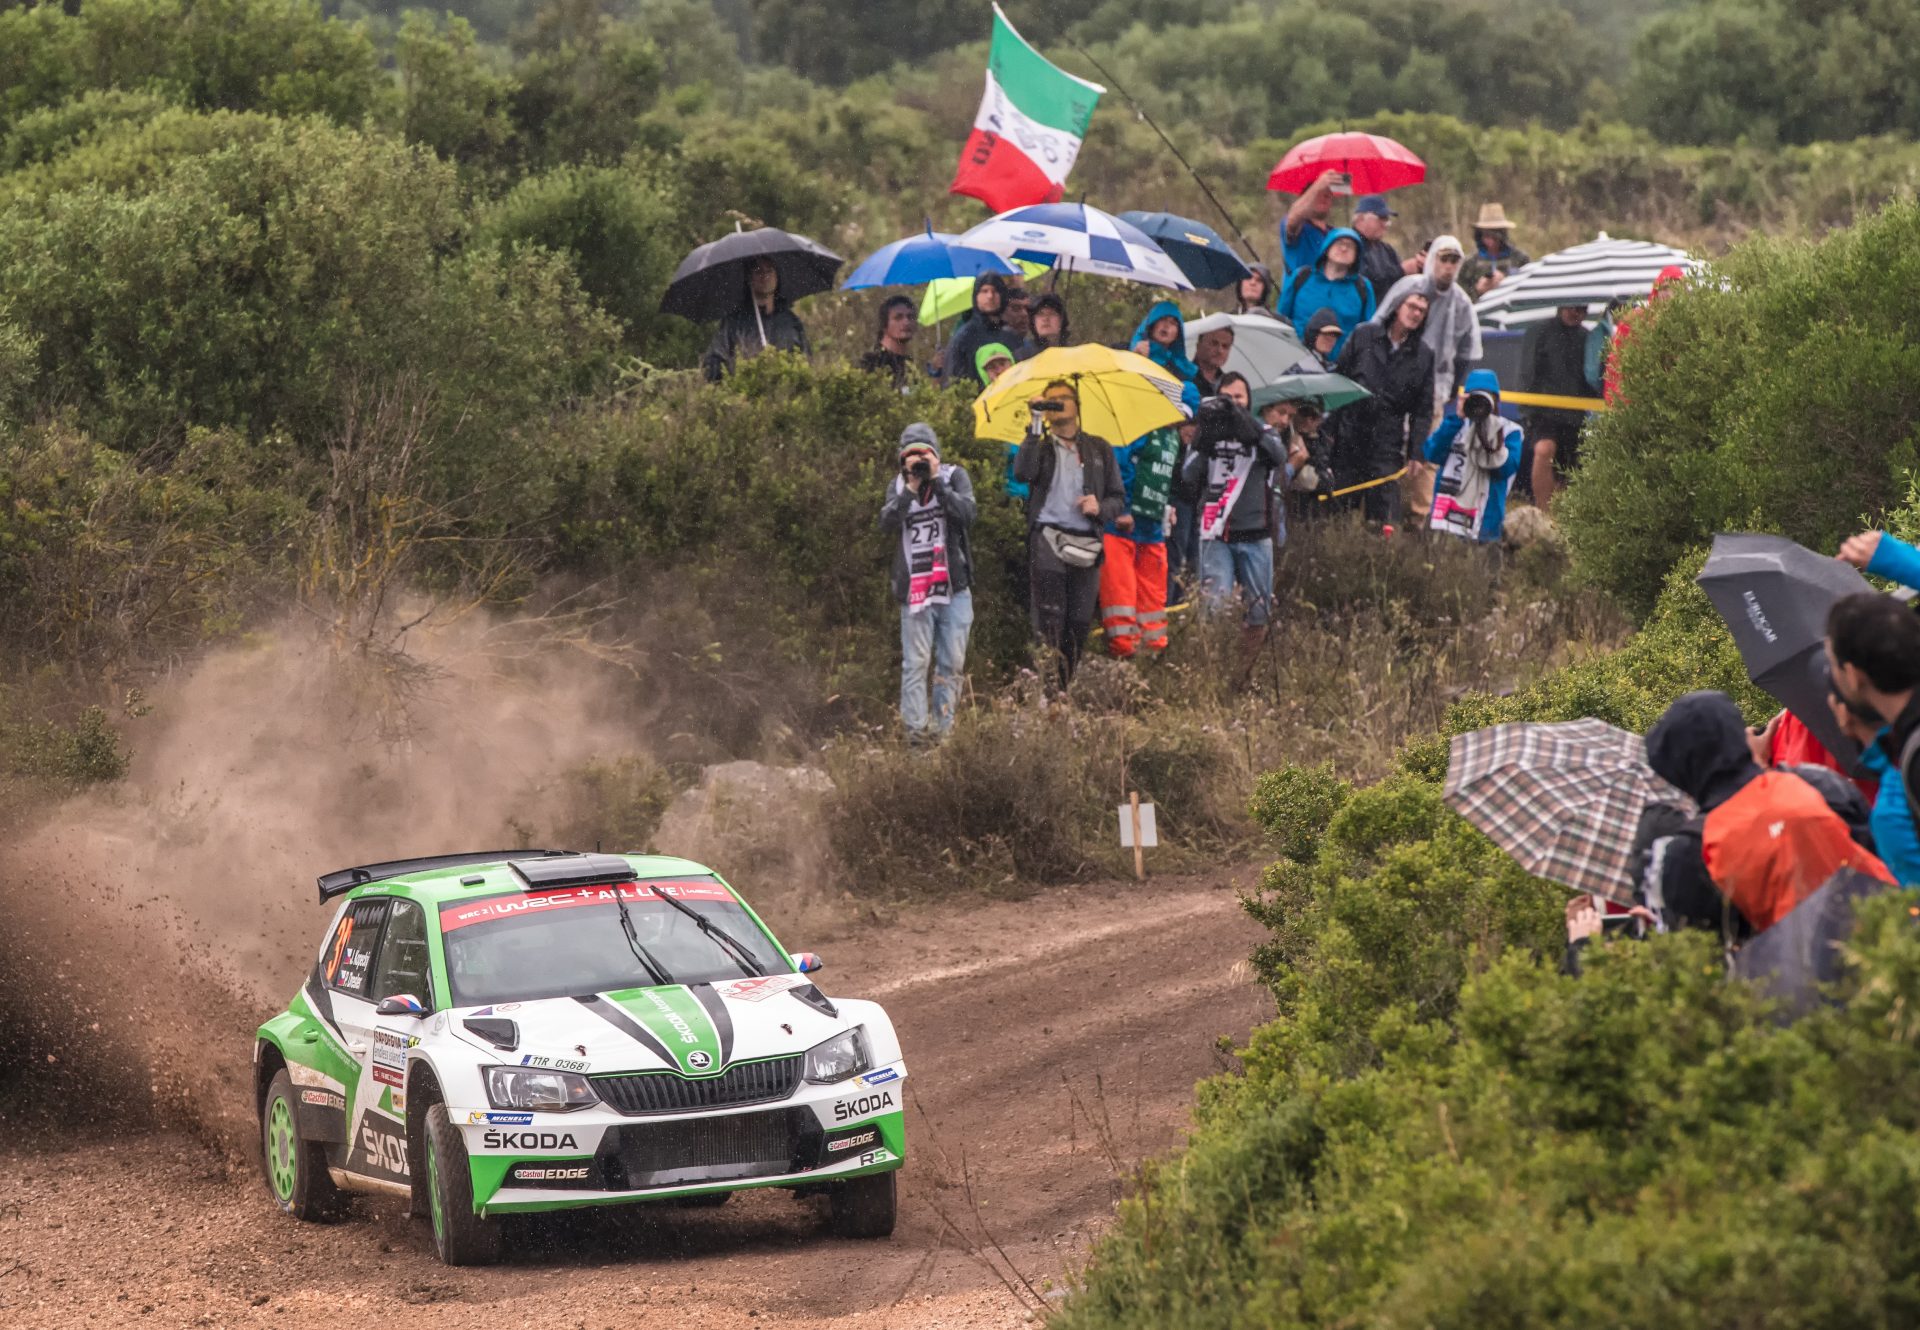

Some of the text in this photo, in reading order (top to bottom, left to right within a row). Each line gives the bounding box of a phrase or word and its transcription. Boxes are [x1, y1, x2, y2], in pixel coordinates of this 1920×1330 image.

[598, 888, 635, 900] ALL
[459, 910, 481, 919] WRC
[663, 1009, 699, 1044] ŠKODA
[555, 1060, 584, 1070] 0368
[868, 1070, 896, 1082] MICHELIN
[306, 1091, 328, 1104] Castrol
[834, 1091, 894, 1121] ŠKODA
[483, 1128, 579, 1150] ŠKODA
[832, 1132, 875, 1150] Castrol EDGE
[860, 1150, 887, 1166] R5
[521, 1168, 589, 1179] Castrol EDGE
